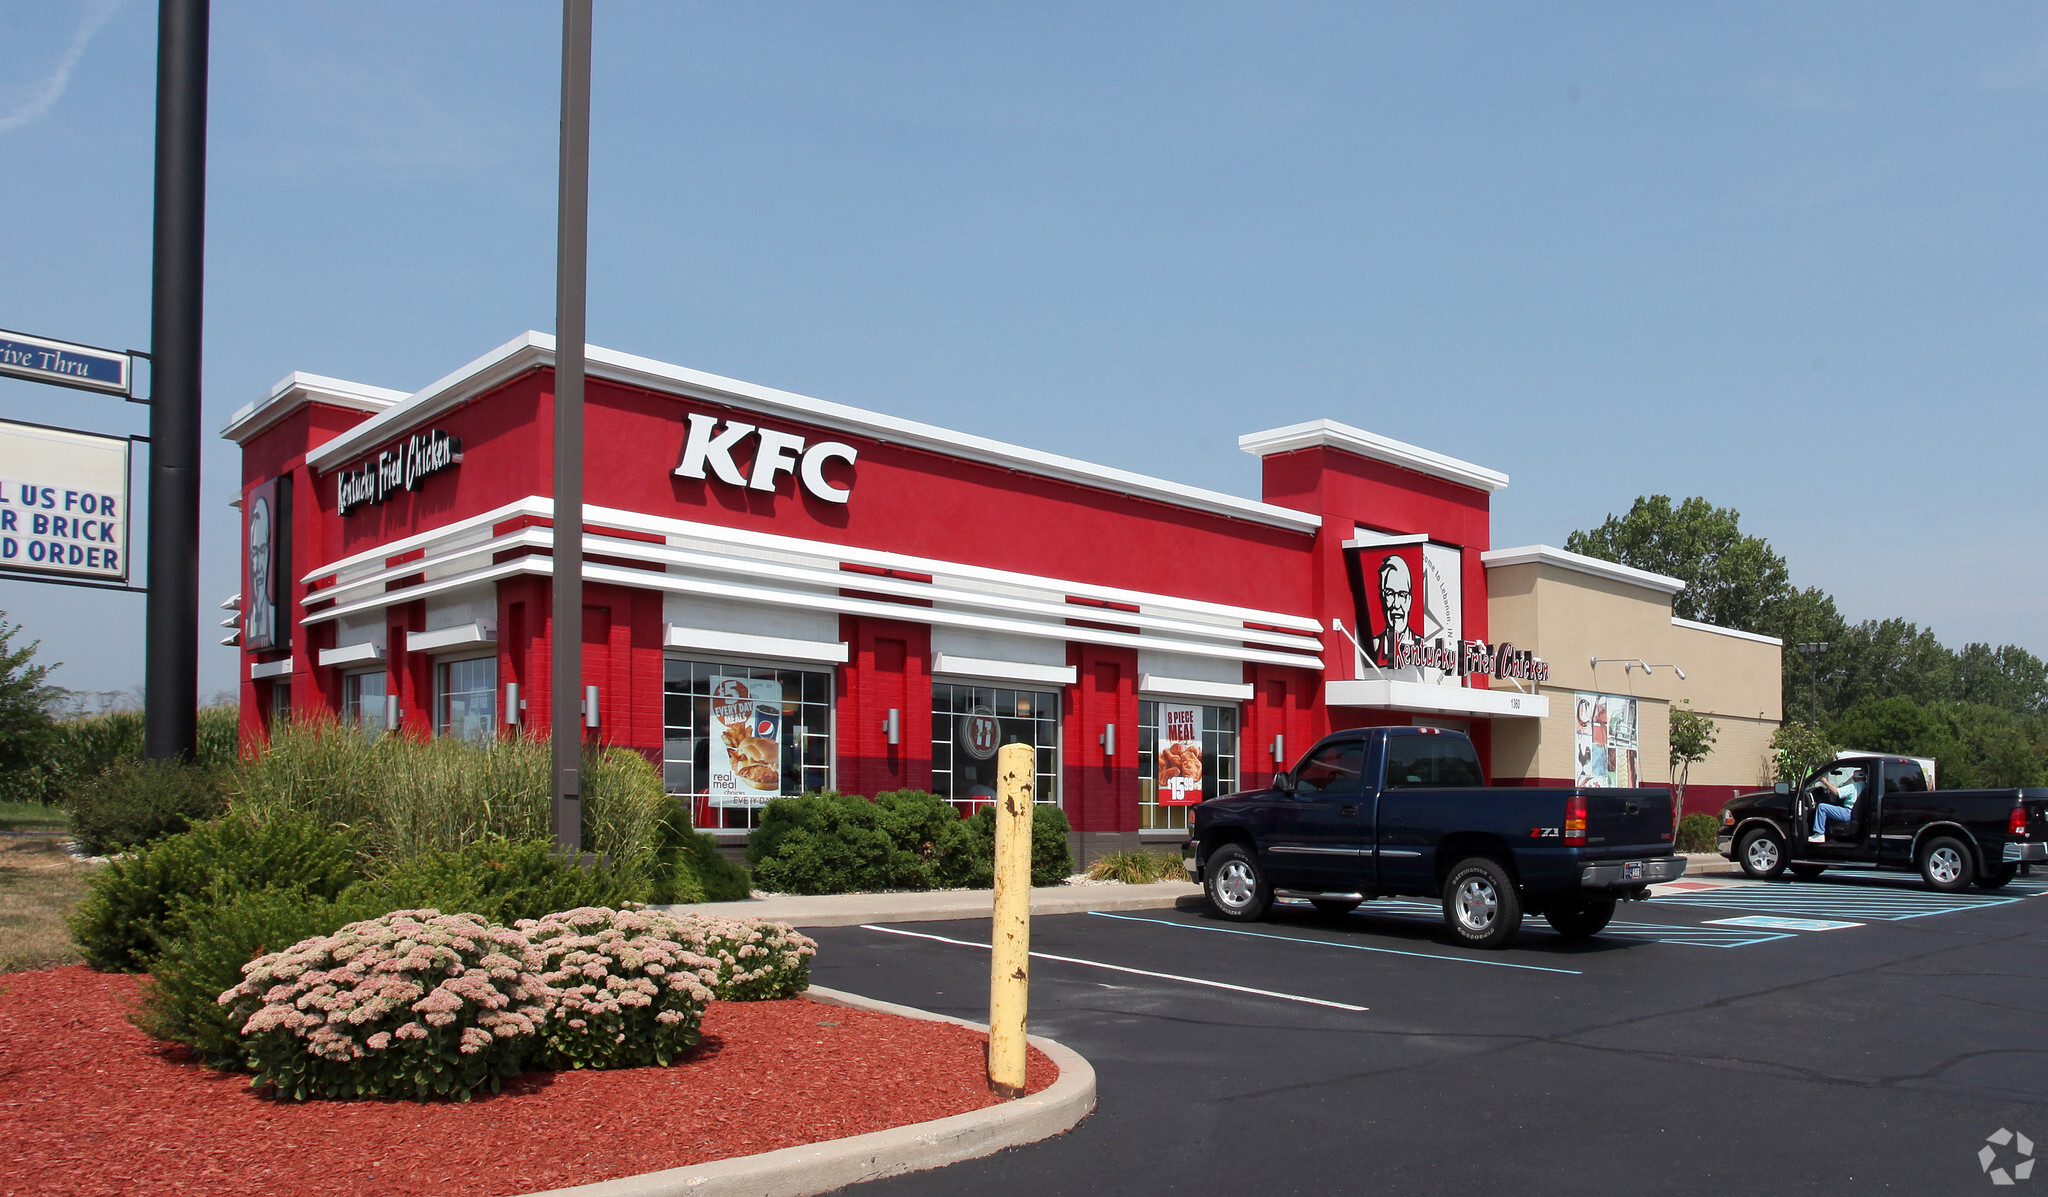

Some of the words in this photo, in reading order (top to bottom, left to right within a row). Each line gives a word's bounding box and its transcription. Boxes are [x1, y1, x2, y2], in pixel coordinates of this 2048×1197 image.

[0, 343, 32, 366] ive
[38, 351, 89, 376] Thru
[674, 412, 858, 504] KFC
[337, 462, 376, 517] Kentucky
[379, 443, 403, 501] Fried
[406, 428, 451, 492] Chicken
[21, 484, 56, 509] US
[64, 490, 116, 517] FOR
[33, 513, 116, 543] BRICK
[28, 540, 119, 570] ORDER
[1393, 631, 1456, 676] Kentucky
[1463, 640, 1497, 677] Fried
[1501, 642, 1551, 682] Chicken
[715, 704, 738, 718] EVERY
[739, 701, 753, 713] DAY
[724, 713, 747, 726] MEALS
[1168, 712, 1173, 724] 8
[1174, 711, 1194, 724] PIECE
[1168, 724, 1195, 742] MEAL
[713, 770, 732, 782] real
[713, 778, 737, 789] meal
[1529, 827, 1559, 838] Z71
